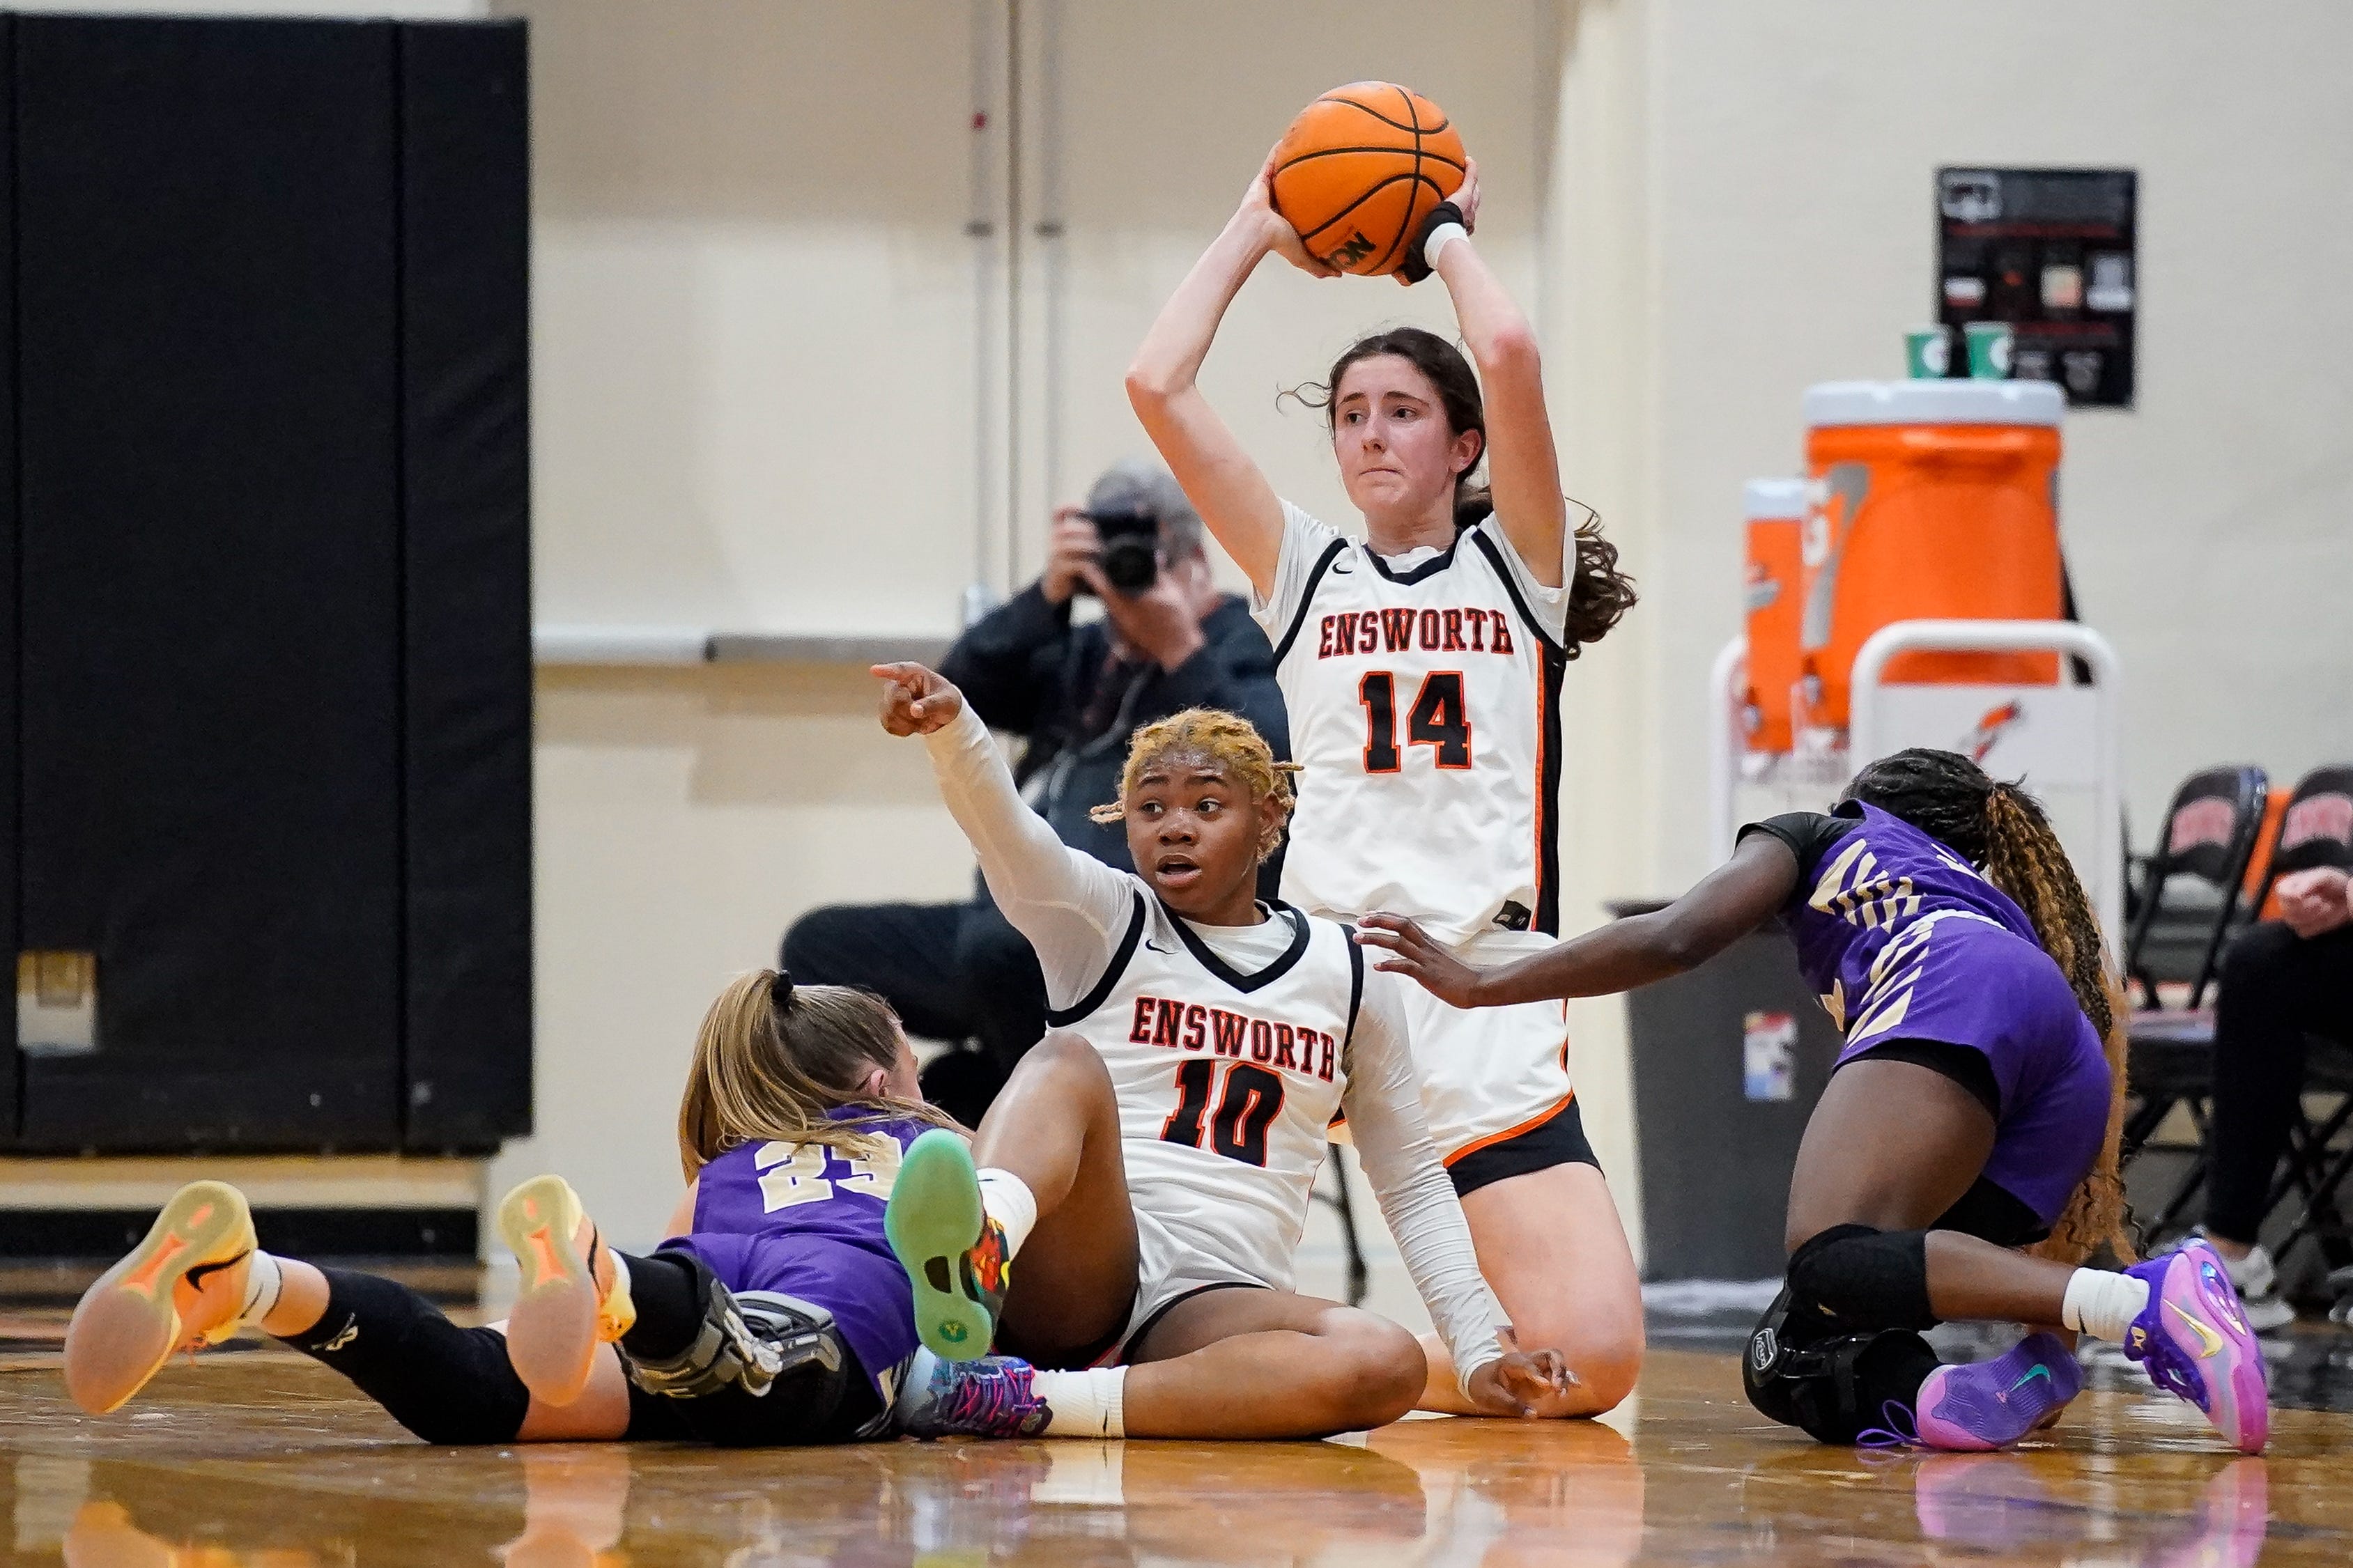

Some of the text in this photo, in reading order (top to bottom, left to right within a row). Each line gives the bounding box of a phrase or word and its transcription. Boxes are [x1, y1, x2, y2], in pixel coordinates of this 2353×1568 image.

[1318, 607, 1515, 660] ENSWORTH
[1358, 670, 1472, 774] 14
[1129, 996, 1336, 1083] ENSWORTH
[1160, 1059, 1285, 1168] 10
[754, 1131, 904, 1215] 23
